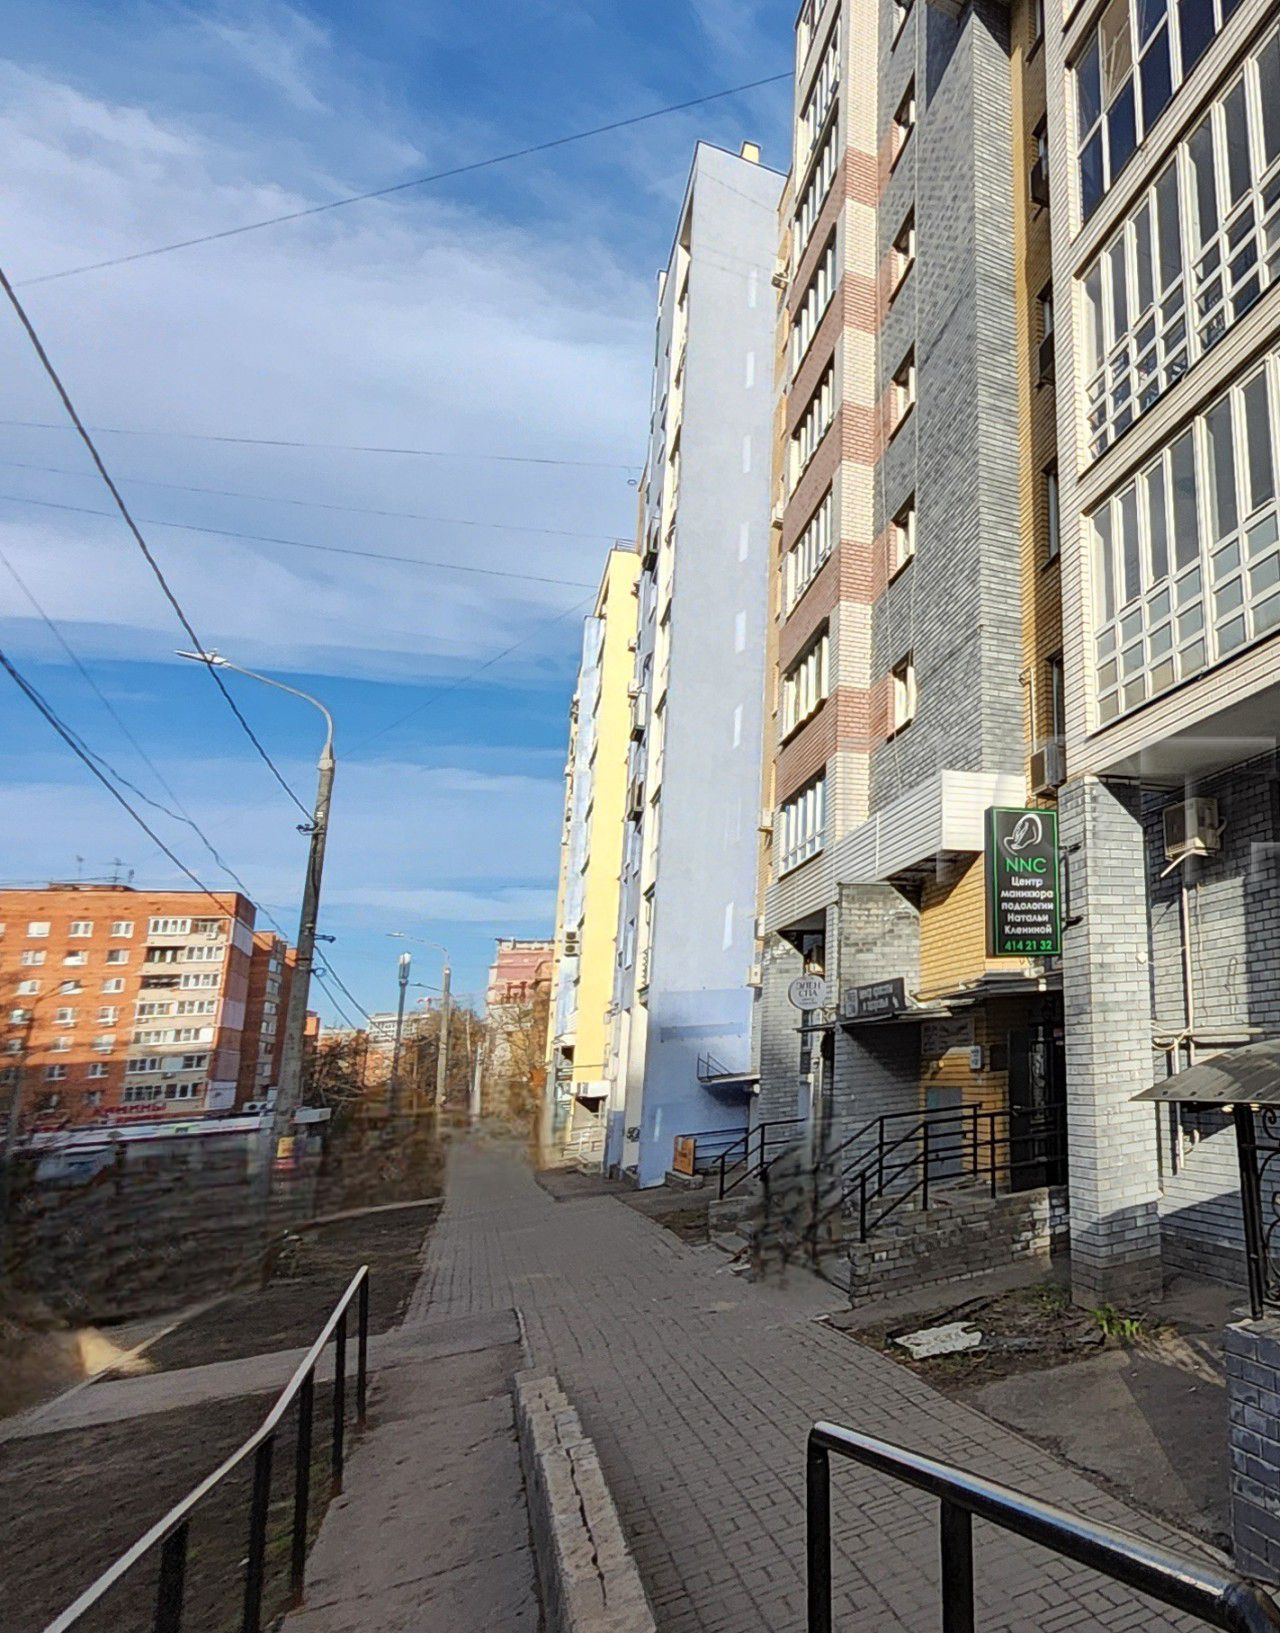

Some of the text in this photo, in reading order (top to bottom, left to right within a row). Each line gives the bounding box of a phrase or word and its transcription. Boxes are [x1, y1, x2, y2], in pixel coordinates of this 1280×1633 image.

[1005, 857, 1048, 873] NNC
[1010, 876, 1044, 888] Центр
[1000, 889, 1055, 899] маникюра
[1000, 901, 1055, 911] подологии
[1006, 913, 1049, 923] Натальи
[1003, 924, 1053, 935] Клениной
[1004, 940, 1053, 951] 414 21 32
